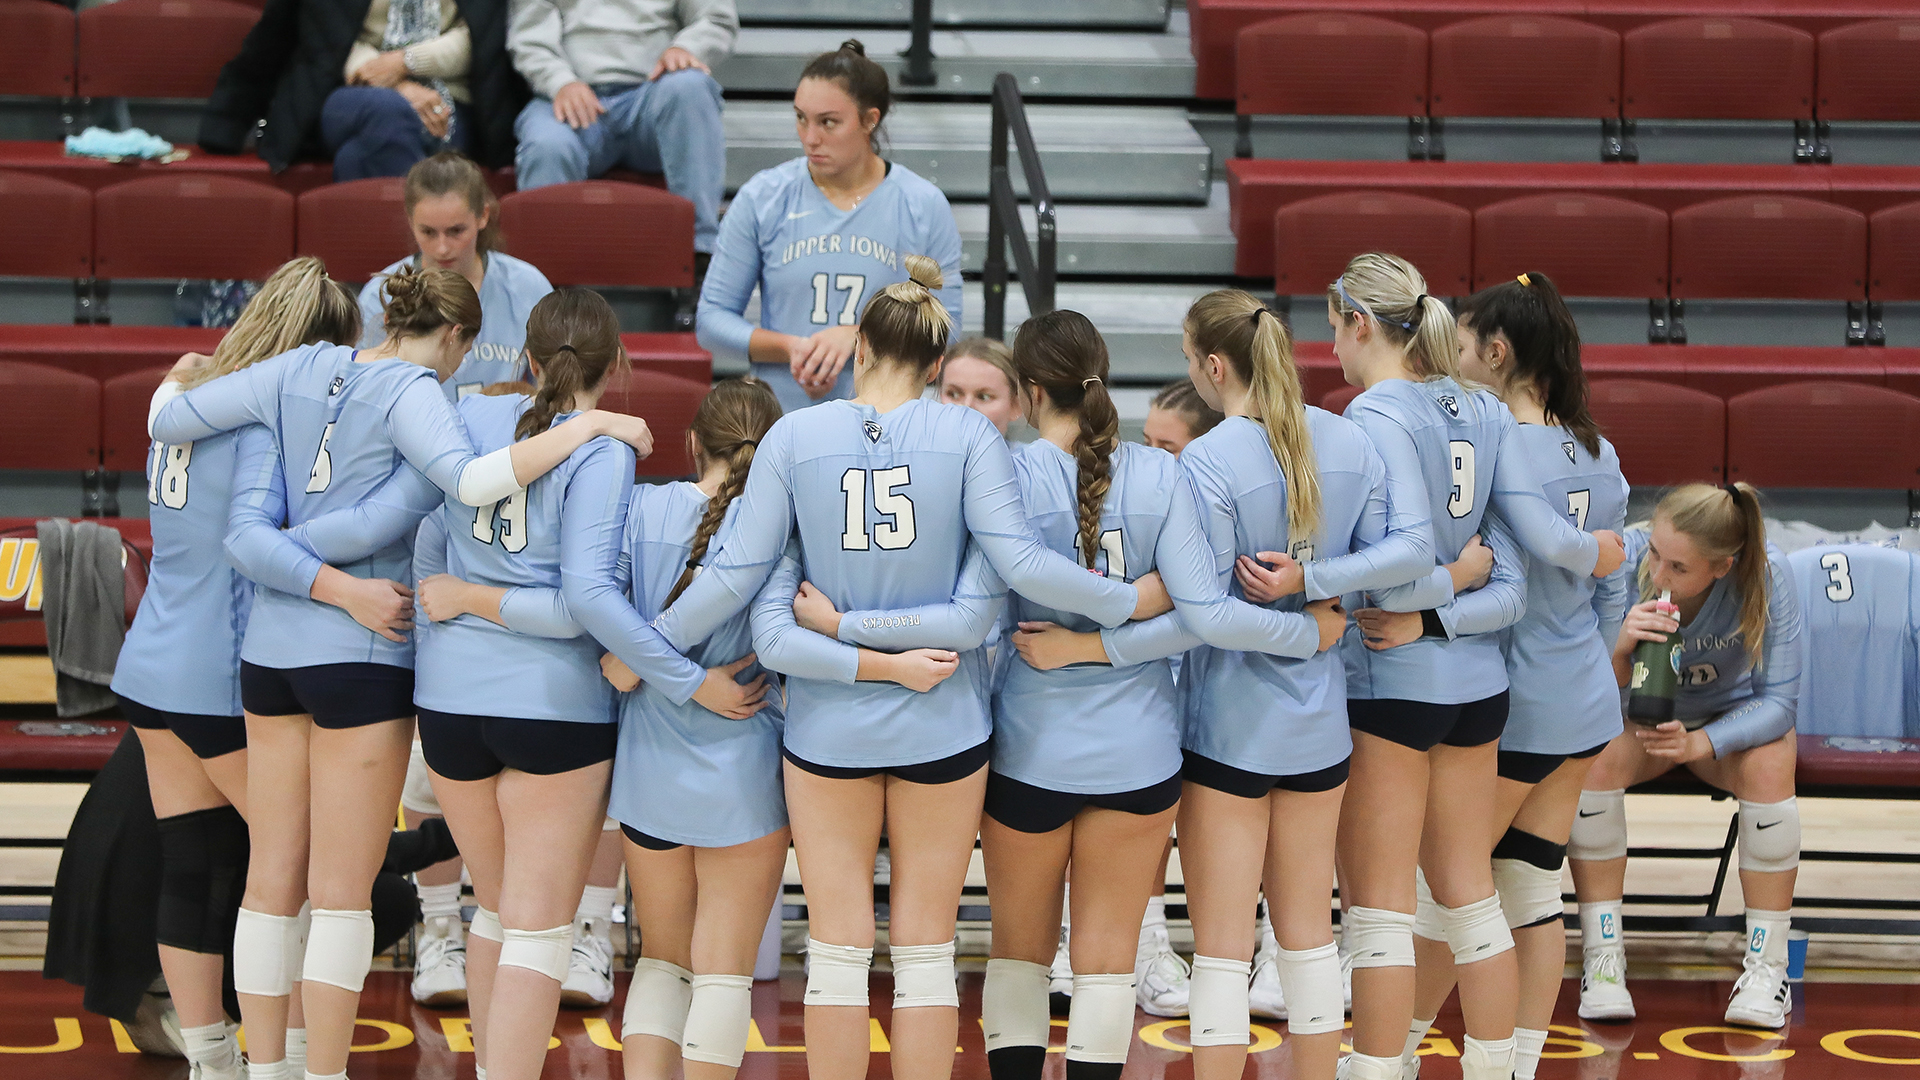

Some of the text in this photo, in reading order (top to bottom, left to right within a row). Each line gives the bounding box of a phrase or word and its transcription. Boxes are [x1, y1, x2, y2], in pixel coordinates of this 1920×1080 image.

[782, 234, 898, 271] UPPER IOWA
[810, 271, 866, 326] 17
[149, 440, 195, 511] 18
[1446, 439, 1476, 519] 9
[840, 464, 917, 551] 15
[1566, 488, 1591, 532] 7
[1820, 551, 1855, 603] 3
[862, 614, 921, 630] PEACOCKS
